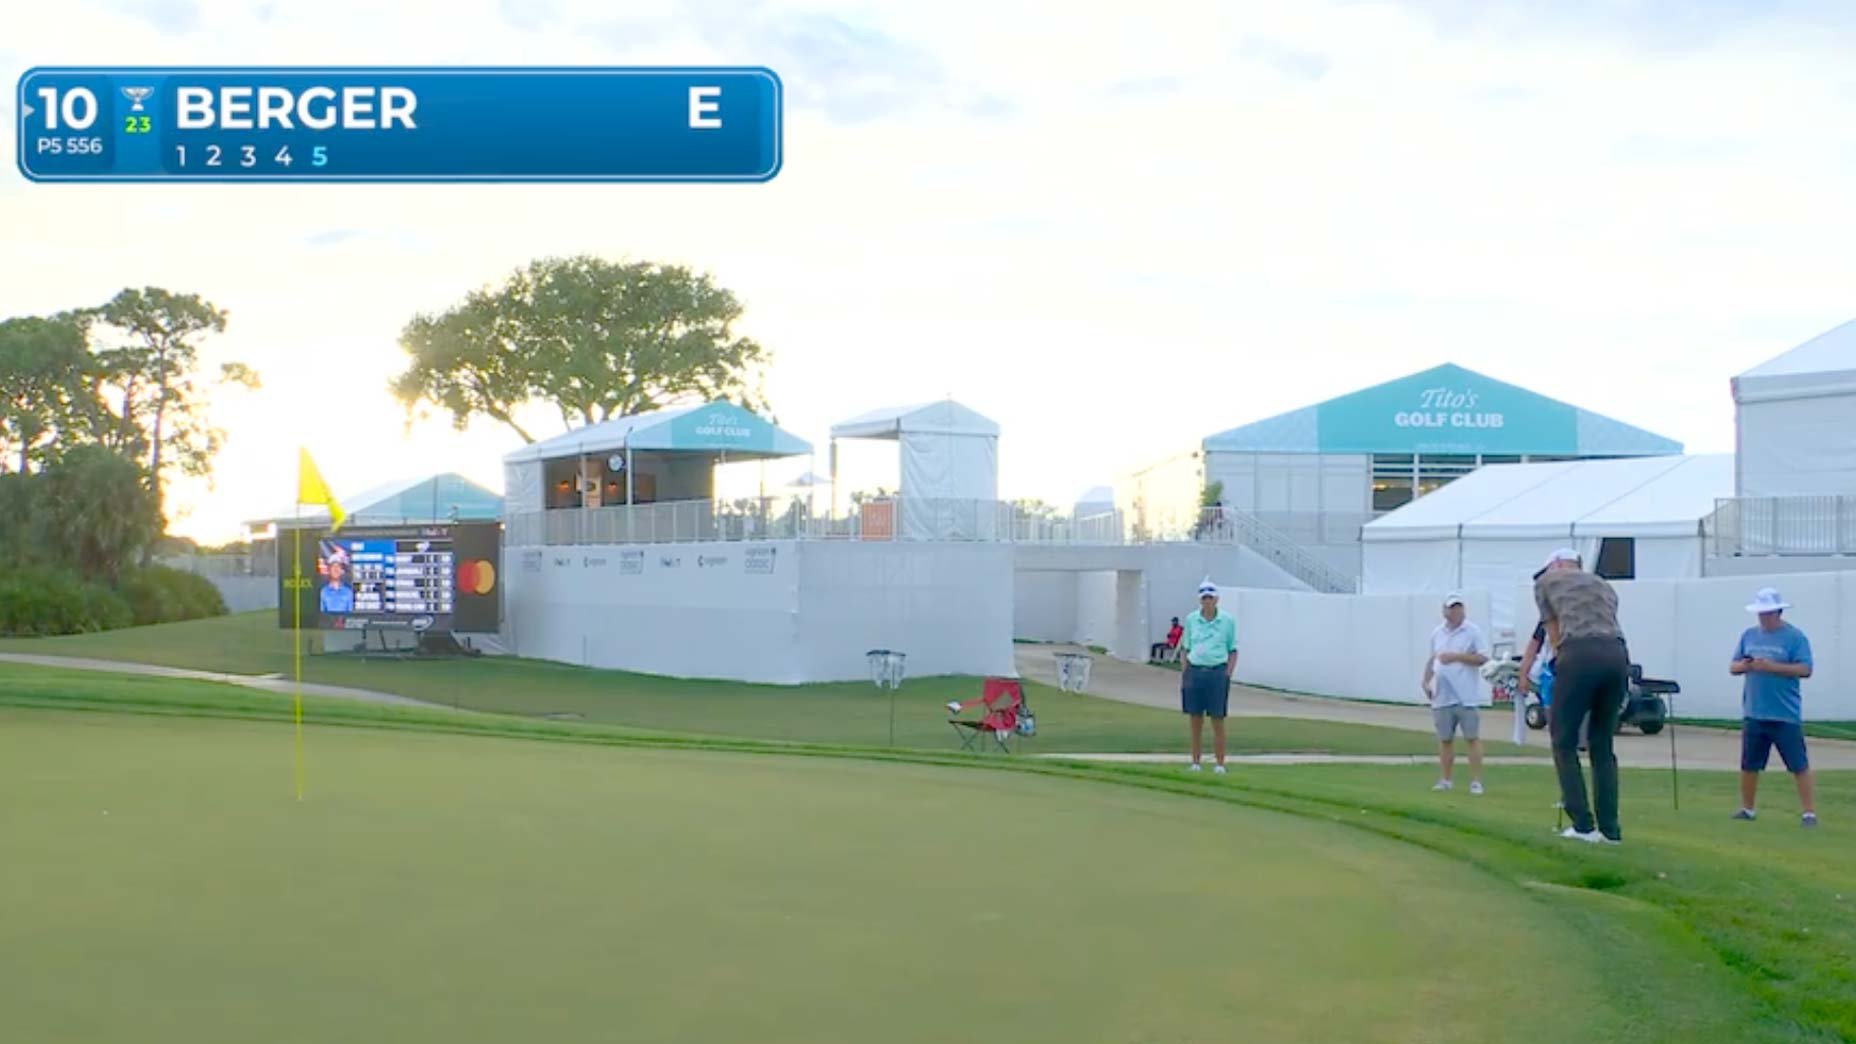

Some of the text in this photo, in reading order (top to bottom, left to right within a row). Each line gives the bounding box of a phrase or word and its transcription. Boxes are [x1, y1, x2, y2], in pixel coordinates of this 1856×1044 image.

[1420, 386, 1480, 409] Tito's
[1394, 411, 1504, 428] GOLF CLUB
